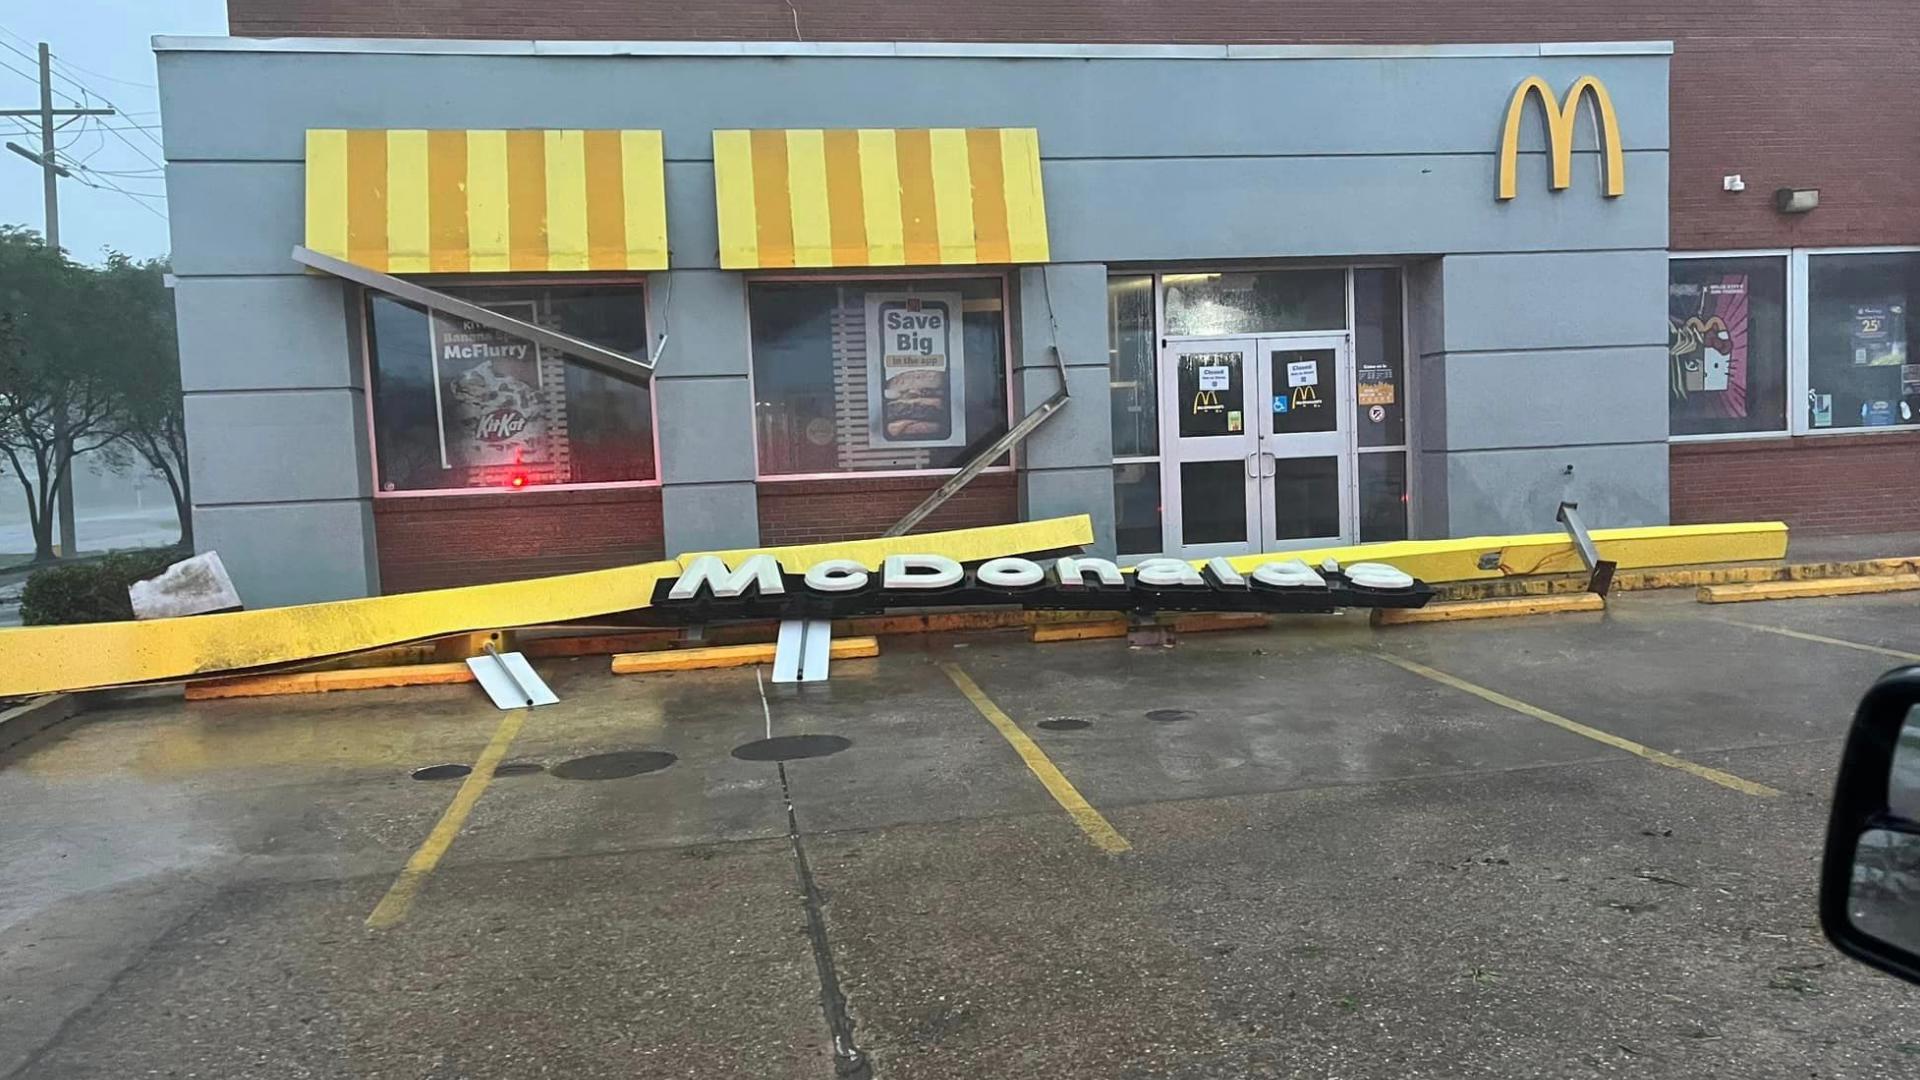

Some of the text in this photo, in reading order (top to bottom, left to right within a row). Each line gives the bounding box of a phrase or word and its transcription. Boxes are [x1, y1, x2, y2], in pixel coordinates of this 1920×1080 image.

[887, 311, 942, 330] Save
[444, 343, 527, 359] McFlurry
[897, 331, 933, 356] Big
[668, 554, 1414, 599] McDonald's
